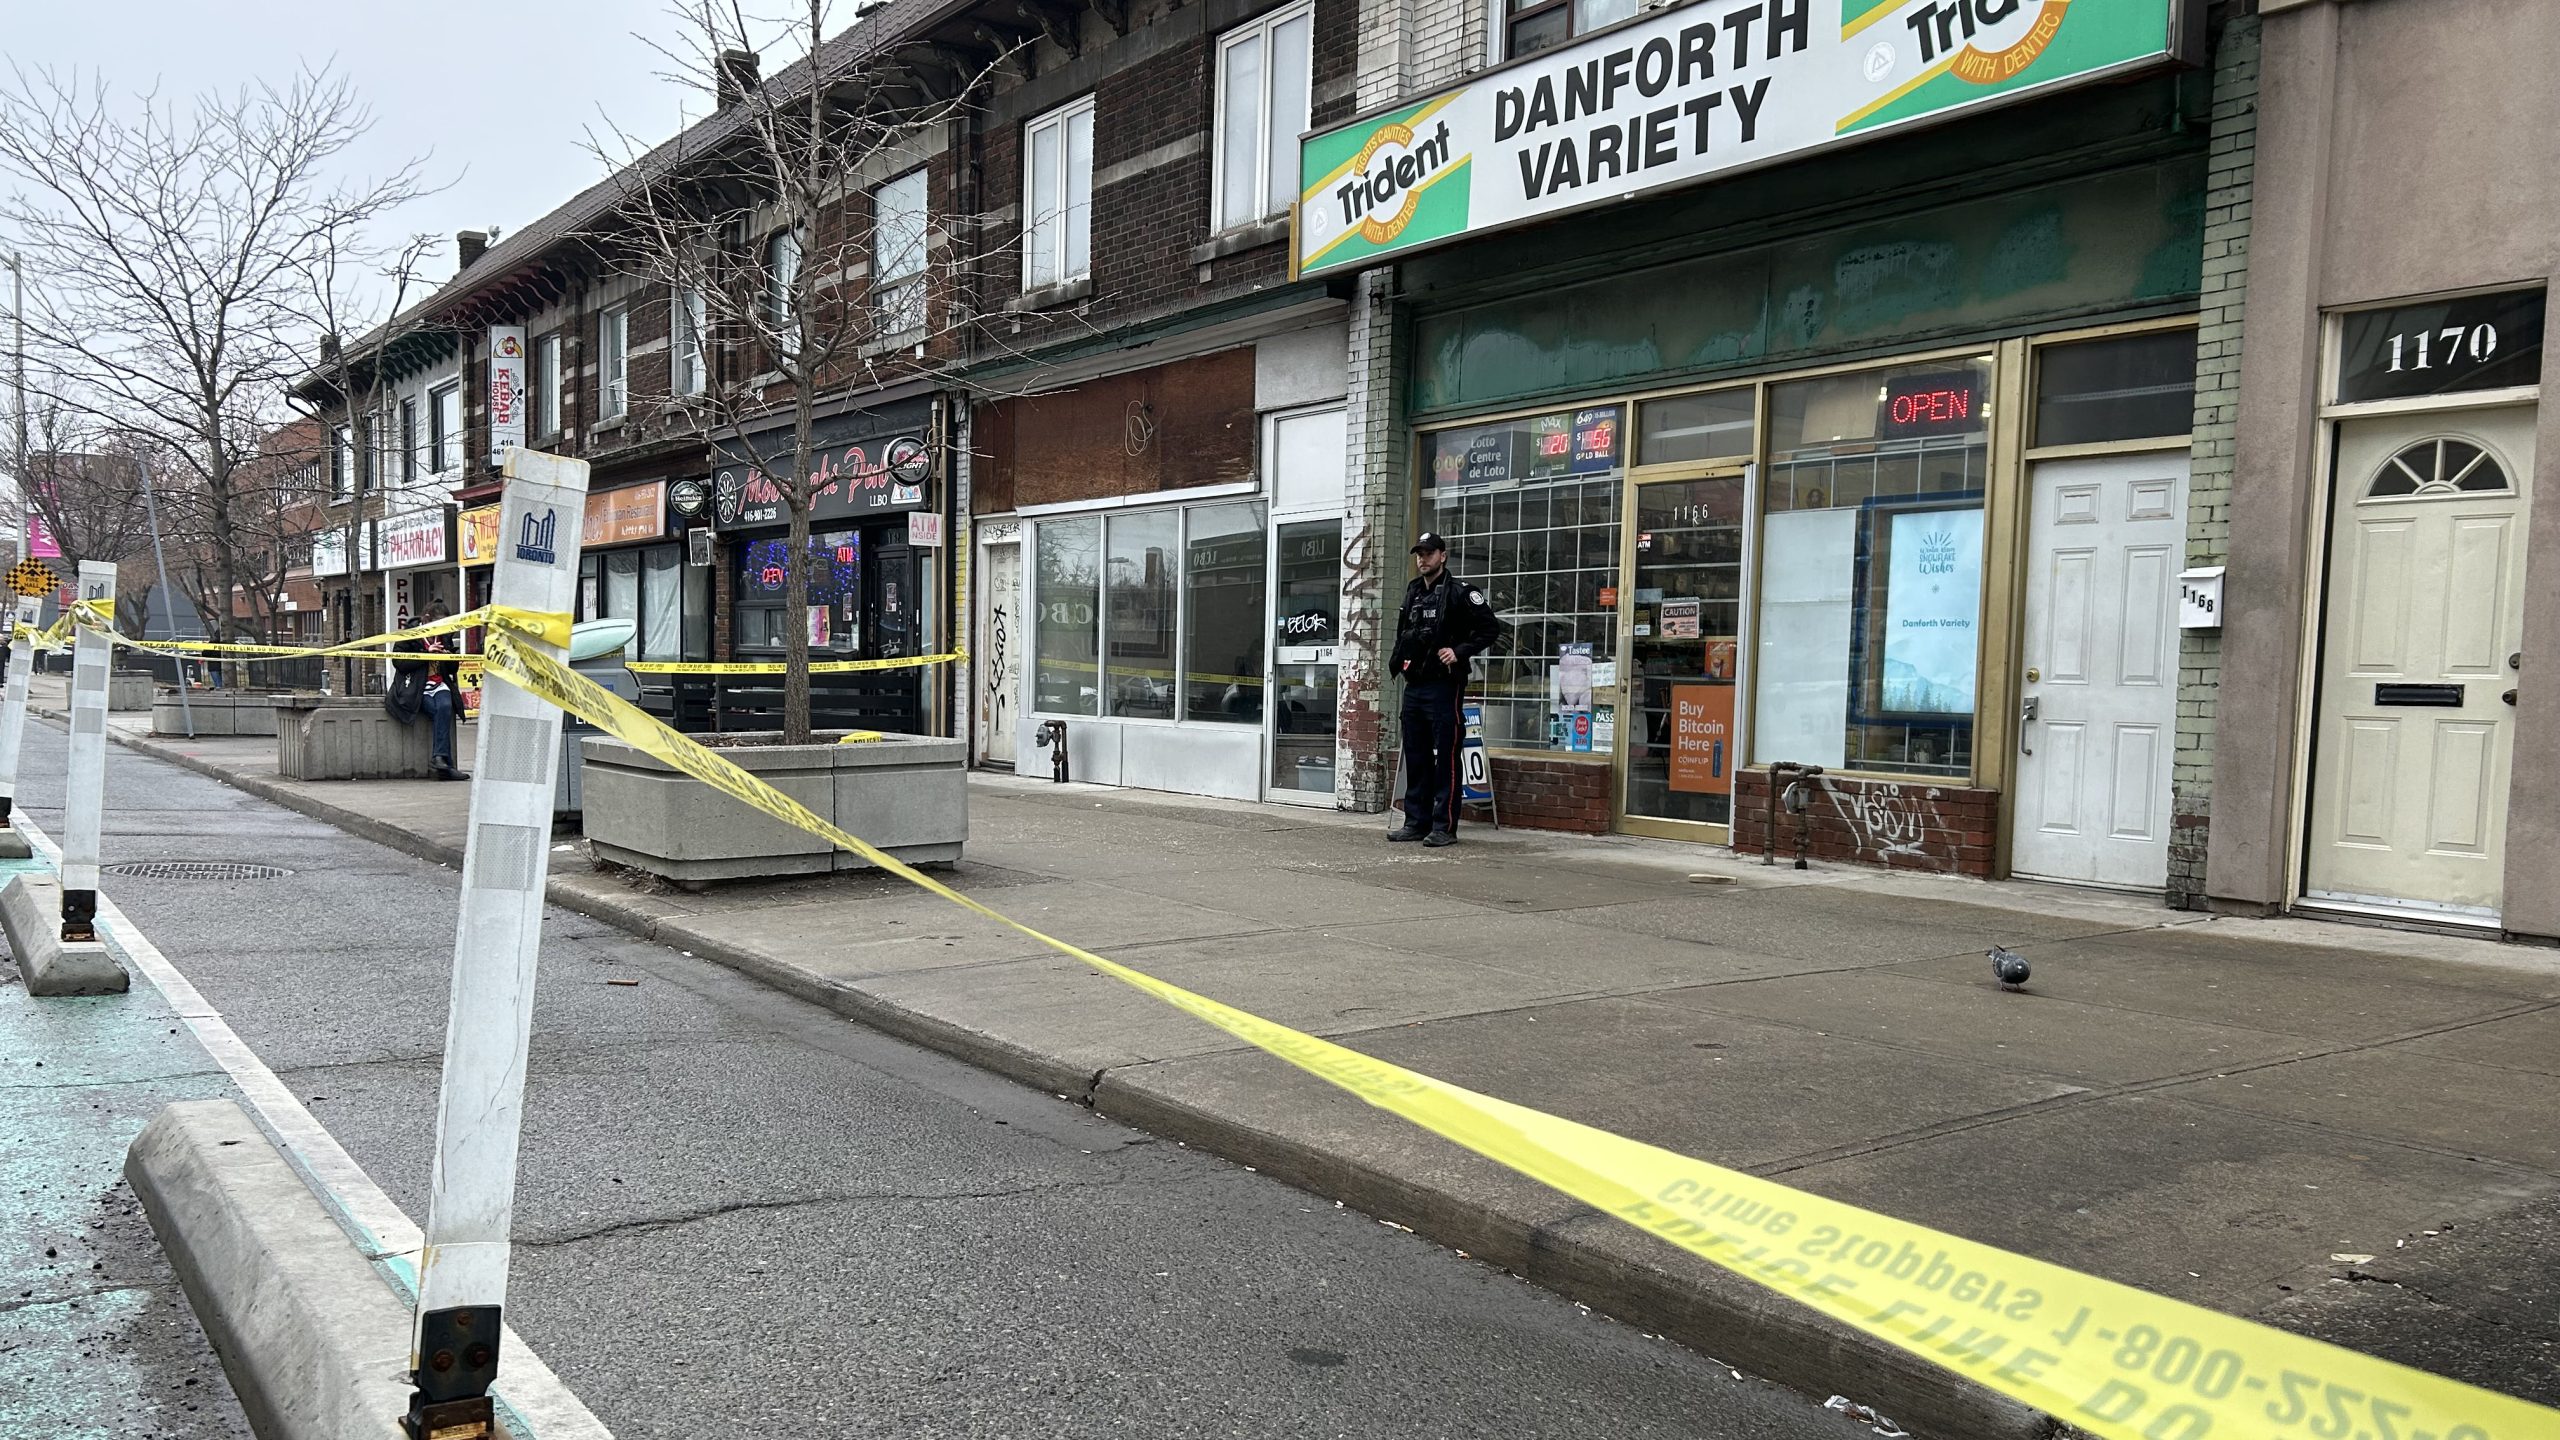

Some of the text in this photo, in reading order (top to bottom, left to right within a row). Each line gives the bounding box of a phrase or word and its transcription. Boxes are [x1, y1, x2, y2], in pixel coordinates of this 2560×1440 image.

[1959, 13, 2060, 79] WITH DENTEC
[1495, 0, 1809, 143] DANFORTH
[1518, 77, 1772, 201] VARIETY
[1355, 126, 1411, 175] FIGHTS CAVITIES
[1337, 120, 1450, 225] Trident
[1365, 198, 1416, 241] WITH DENTEC
[2385, 323, 2497, 373] 1170
[498, 368, 509, 424] KEBAB
[1893, 389, 1969, 423] OPEN
[1541, 416, 1560, 431] MAX
[1471, 436, 1496, 449] Lotto
[1470, 451, 1501, 464] Centre
[1469, 465, 1506, 478] de Loto
[869, 494, 888, 507] LLBO
[1674, 504, 1708, 521] 1166
[911, 516, 937, 532] ATM
[390, 527, 444, 564] PHARMACY
[1638, 541, 1650, 549] ATM
[516, 545, 555, 564] TORONTO
[1919, 562, 1954, 574] Wishes
[2182, 585, 2214, 613] 1168
[1664, 607, 1696, 616] CAUTION
[1902, 619, 1970, 629] Danforth Variety
[486, 643, 516, 671] Crime
[1596, 713, 1615, 723] PASS
[1679, 701, 1704, 718] Buy
[1679, 719, 1724, 735] Bitcoin
[1678, 736, 1710, 751] Here
[1678, 756, 1709, 765] COINFLIP
